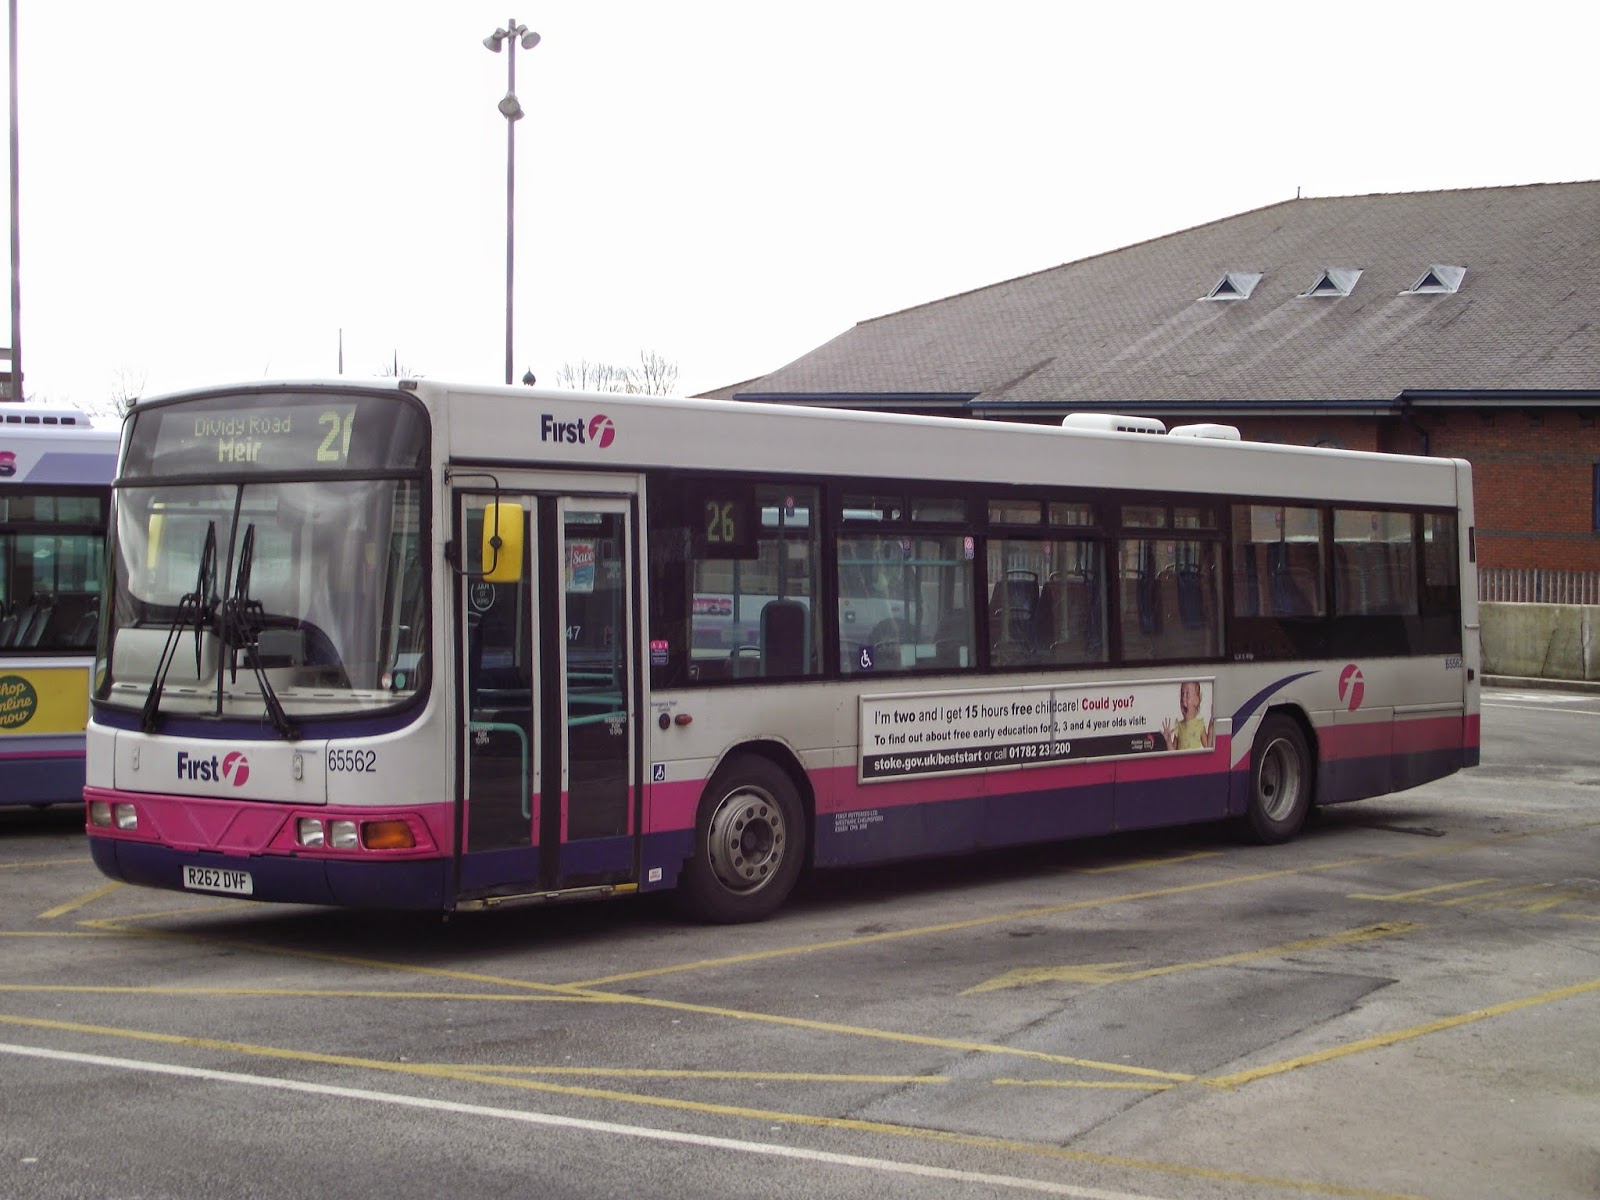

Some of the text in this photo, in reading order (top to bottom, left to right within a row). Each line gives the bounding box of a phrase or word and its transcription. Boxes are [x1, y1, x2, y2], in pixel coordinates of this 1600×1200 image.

[250, 415, 292, 434] Road
[541, 414, 586, 444] First
[218, 436, 262, 463] Meir
[706, 500, 735, 543] 26
[0, 696, 33, 712] nline
[874, 710, 891, 725] I'm
[894, 710, 916, 724] two
[918, 707, 938, 722] and
[946, 705, 962, 724] get
[965, 705, 978, 719] 15
[981, 704, 1009, 718] hours
[1011, 702, 1033, 716] free
[1081, 697, 1110, 711] Could
[1112, 695, 1135, 712] you?
[874, 734, 886, 746] To
[888, 732, 906, 745] find
[908, 732, 923, 743] out
[925, 730, 951, 742] about
[953, 728, 971, 740] free
[973, 726, 995, 741] early
[997, 723, 1038, 737] education
[1040, 722, 1051, 734] for
[1062, 720, 1068, 731] 3
[1069, 719, 1085, 731] and
[1086, 719, 1091, 729] 4
[1092, 718, 1109, 732] year
[1111, 716, 1127, 728] olds
[1129, 715, 1147, 727] visit:
[177, 751, 219, 782] First
[329, 749, 377, 773] 65562
[874, 750, 983, 771] stoke.gov.uk/beststart
[984, 752, 993, 761] or
[993, 747, 1008, 760] call
[1009, 745, 1037, 759] 01782
[188, 869, 247, 890] R262 DVF
